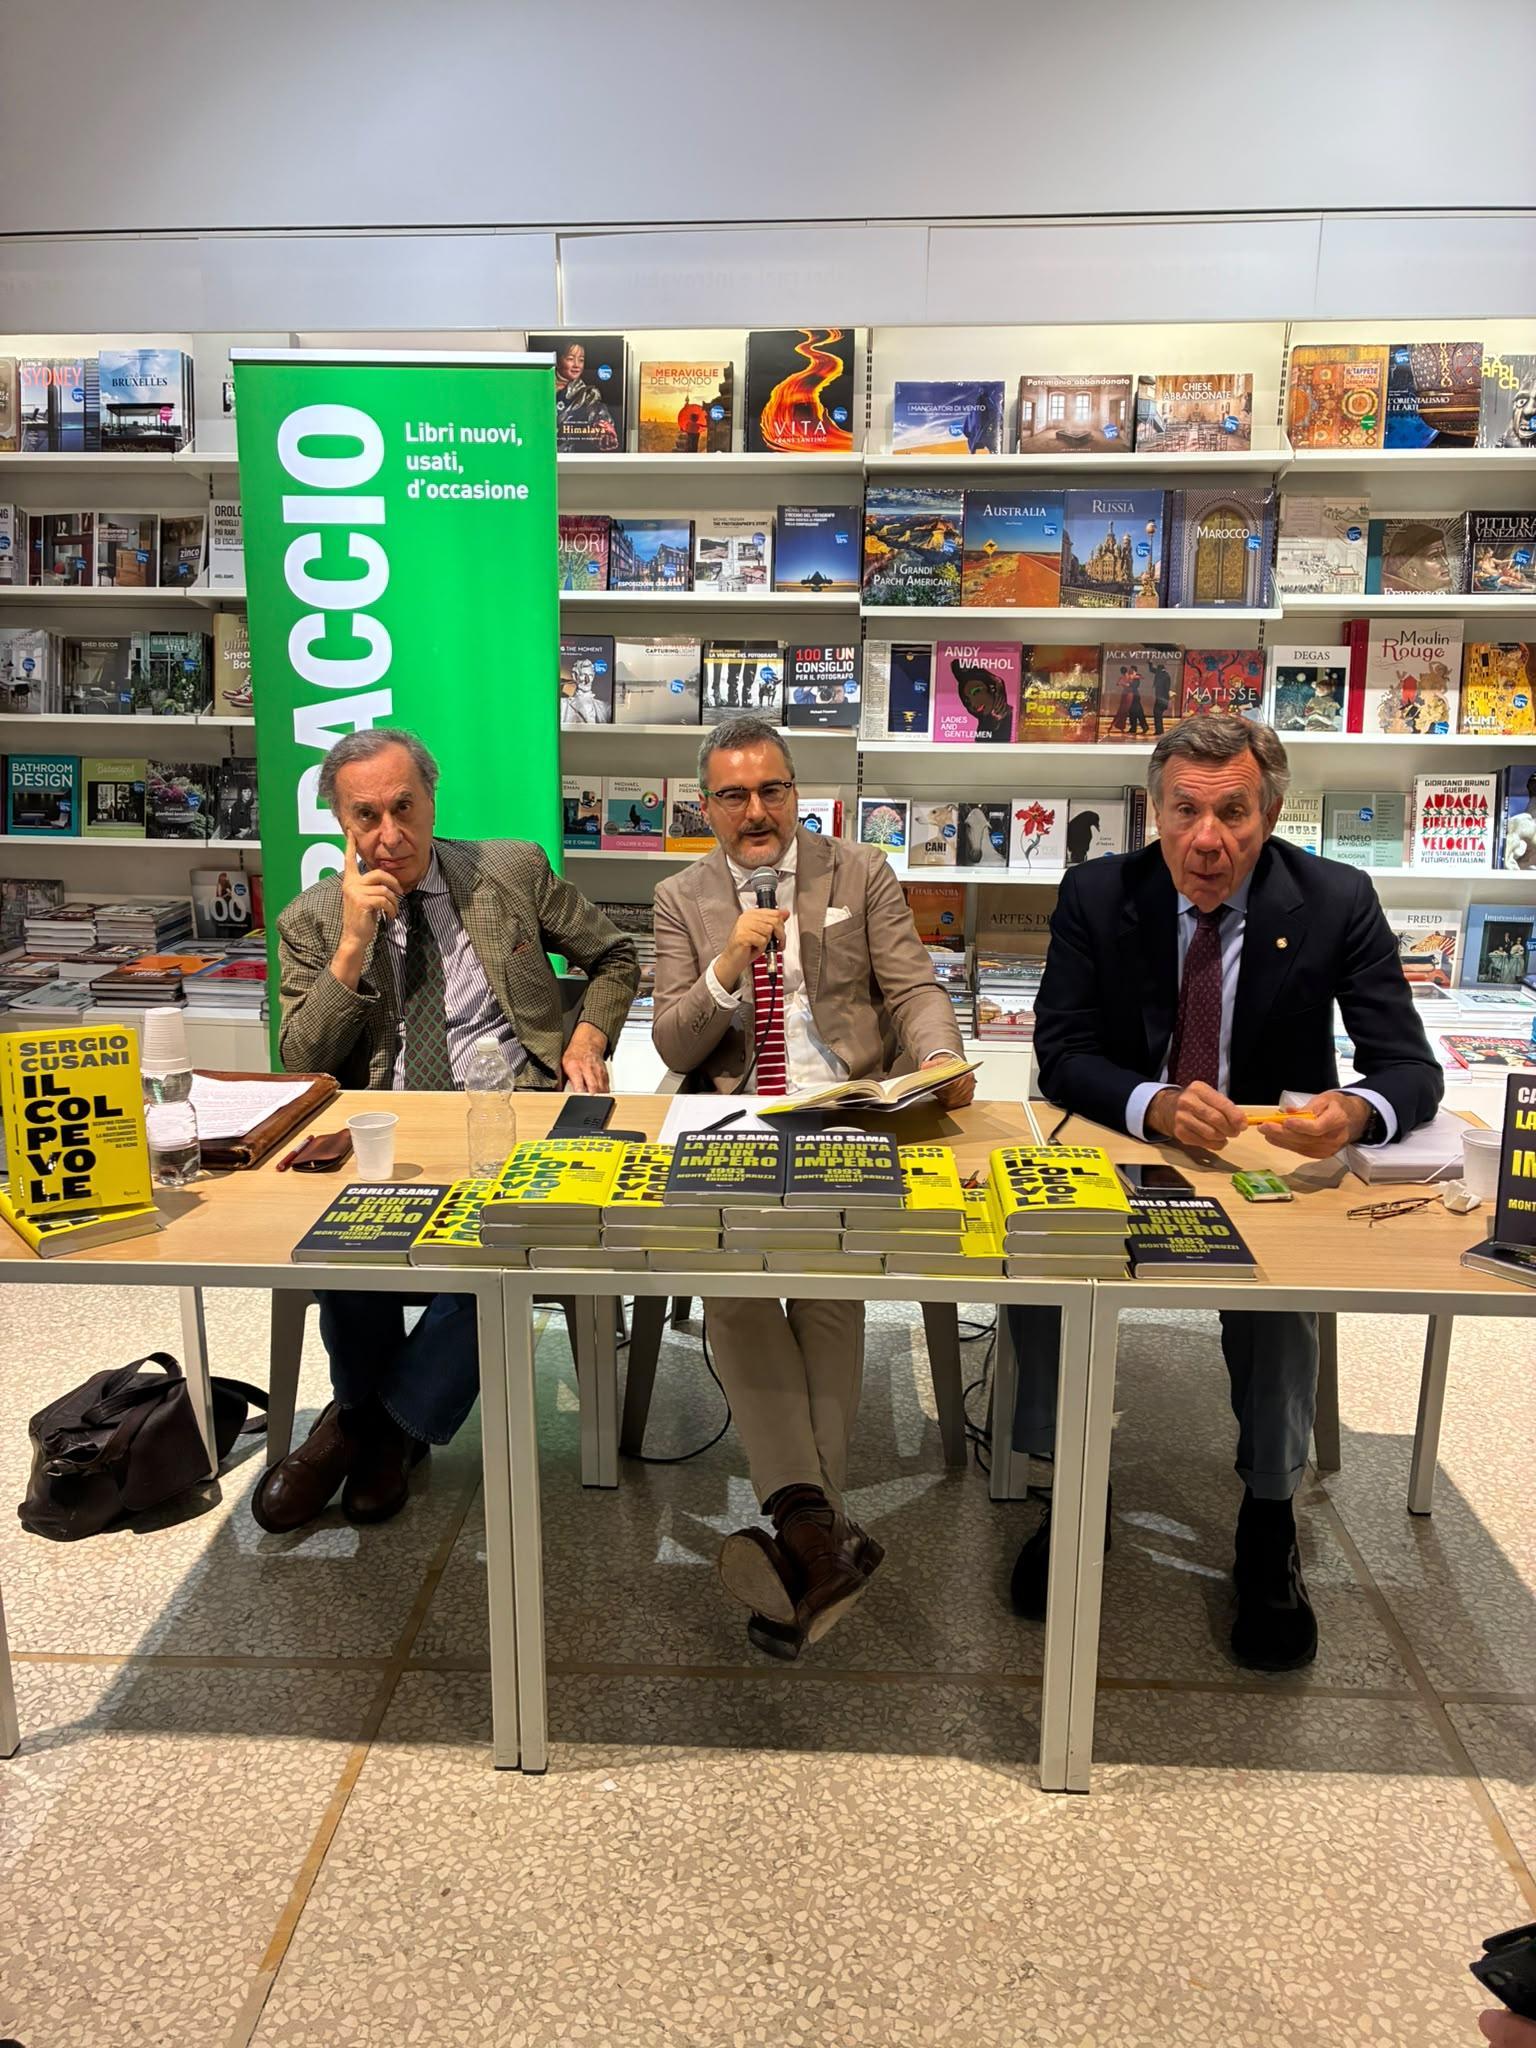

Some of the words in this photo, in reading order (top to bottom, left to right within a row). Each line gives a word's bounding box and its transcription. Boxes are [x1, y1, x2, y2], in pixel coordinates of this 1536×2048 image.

[22, 367, 82, 388] SYDNEY
[655, 368, 719, 378] MERAVIGLIE
[112, 377, 168, 387] BRUXELLES
[651, 377, 663, 385] DEL
[666, 377, 711, 385] MONDO
[1027, 378, 1072, 386] Patrimonio
[1074, 377, 1130, 385] abbandonato
[1183, 383, 1213, 391] CHIESE
[1164, 391, 1231, 400] ABBANDONATE
[963, 404, 986, 412] VENTO
[563, 425, 606, 436] Himalaya
[774, 420, 826, 435] VITA
[405, 422, 454, 443] Libri
[460, 422, 523, 446] nuovi,
[406, 451, 464, 474] usati,
[407, 479, 529, 499] d'occasione
[983, 504, 1047, 517] AUSTRALIA
[1092, 499, 1135, 513] RUSSIA
[1197, 526, 1250, 539] MAROCCO
[180, 547, 200, 558] zinco
[900, 563, 933, 575] GRANDI
[873, 575, 904, 586] PARCHI
[907, 575, 951, 586] AMERICANI
[1400, 630, 1450, 646] Moulin
[796, 649, 821, 661] 100
[825, 649, 833, 660] E
[836, 647, 855, 660] UN
[945, 646, 980, 657] ANDY
[1106, 651, 1127, 659] JACK
[1129, 650, 1182, 660] VETTRIANO
[1382, 638, 1445, 661] Rouge
[1294, 651, 1330, 660] DEGAS
[795, 661, 854, 673] CONSIGLIO
[959, 658, 1014, 669] WARHOL
[817, 672, 854, 680] FOTOGRAFO
[1025, 687, 1086, 699] Camera
[1186, 688, 1258, 700] MATISSE
[1026, 702, 1056, 715] Pop
[1464, 715, 1497, 725] KLIMT
[944, 730, 992, 738] GENTLEMEN
[12, 763, 72, 773] BATHROOM
[12, 774, 73, 787] DESIGN
[1424, 794, 1489, 809] AUDACIA
[925, 842, 947, 852] CANI
[909, 886, 960, 897] THAILANDIA
[197, 896, 247, 922] 100
[990, 913, 1033, 925] ARTES
[1408, 914, 1442, 924] FREUD
[1484, 912, 1535, 922] Impressionisti
[19, 1035, 129, 1057] SERGIO
[20, 1051, 130, 1072] CUSANI
[23, 1073, 70, 1099] IL
[25, 1095, 123, 1125] COL
[27, 1123, 90, 1151] PE
[737, 1134, 780, 1142] SAMA
[846, 1135, 889, 1143] SAMA
[684, 1142, 704, 1150] LA
[708, 1142, 779, 1150] CADUTA
[795, 1143, 816, 1151] LA
[819, 1143, 891, 1152] CADUTA
[26, 1148, 96, 1176] VO
[513, 1153, 553, 1162] IL
[623, 1156, 664, 1164] IL
[680, 1156, 777, 1167] IMPERO
[794, 1157, 892, 1168] IMPERO
[508, 1161, 595, 1170] COL
[1005, 1159, 1048, 1168] IL
[502, 1170, 561, 1180] PE
[1008, 1167, 1099, 1177] COL
[500, 1180, 561, 1190] VO
[1010, 1176, 1070, 1187] PE
[30, 1174, 92, 1204] LE
[396, 1188, 439, 1196] SAMA
[1011, 1186, 1077, 1196] VO
[492, 1190, 551, 1200] LE
[338, 1196, 360, 1204] LA
[363, 1197, 433, 1206] CADUTA
[1015, 1195, 1076, 1207] LE
[1169, 1200, 1215, 1208] SAMA
[356, 1204, 374, 1212] DI
[379, 1204, 406, 1213] UN
[1147, 1208, 1221, 1217] CADUTA
[323, 1211, 423, 1223] IMPERO
[1150, 1216, 1168, 1224] DI
[1176, 1216, 1200, 1225] UN
[1129, 1223, 1230, 1236] IMPERO
[422, 1230, 480, 1241] LE
